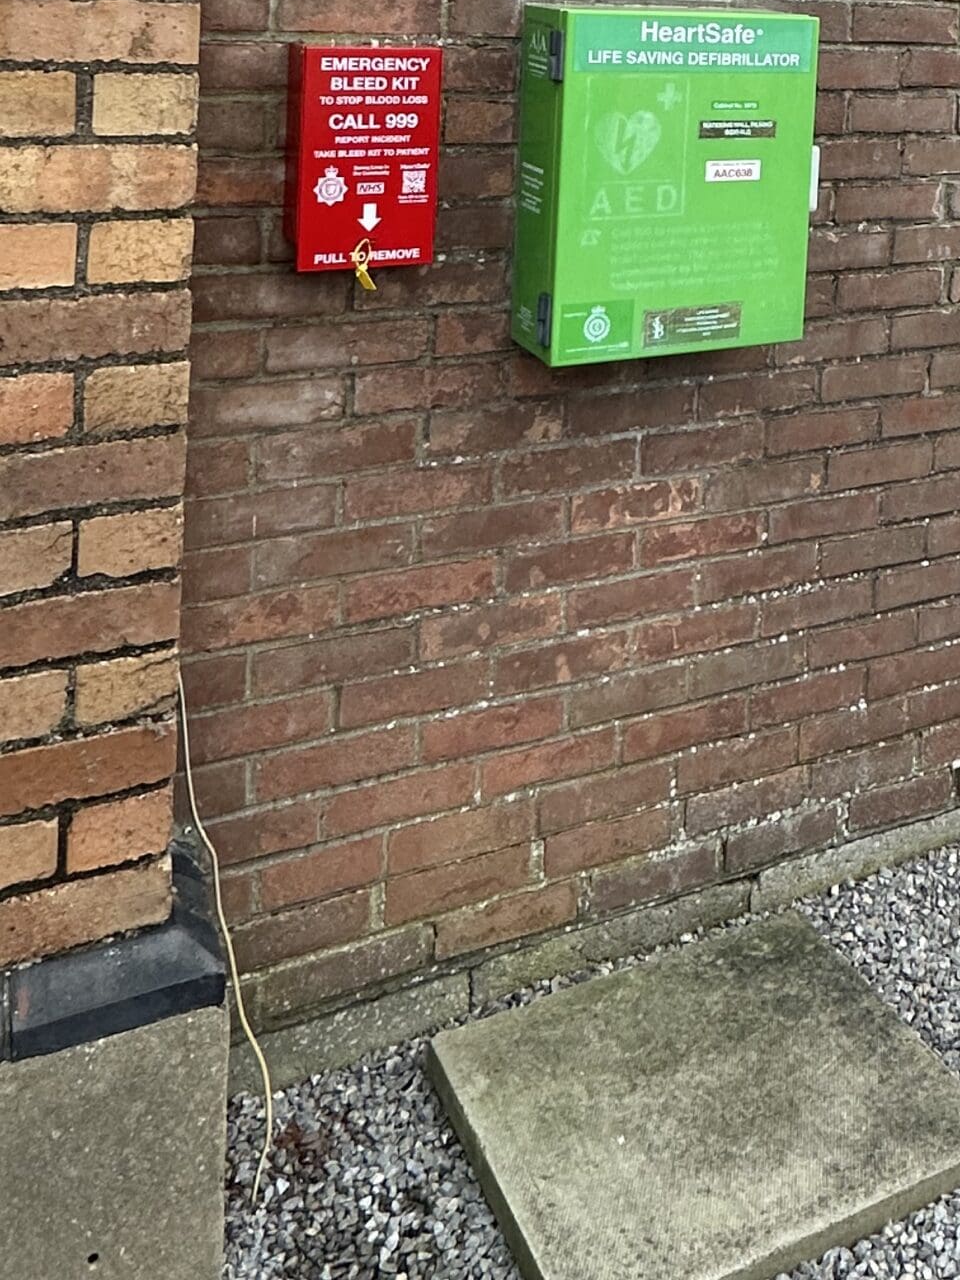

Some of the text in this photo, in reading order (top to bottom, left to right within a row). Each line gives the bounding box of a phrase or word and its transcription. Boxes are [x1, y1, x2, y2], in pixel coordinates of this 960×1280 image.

[321, 57, 430, 71] EMERGENCY
[588, 50, 800, 67] LIFE SAVING DEFIBRILLATOR
[330, 77, 420, 90] BLEED KIT
[319, 95, 428, 106] TO STOP BLOOD LOSS
[328, 113, 419, 130] CALL 999
[335, 135, 411, 144] REPORT INCIDENT
[383, 148, 395, 156] TO
[314, 248, 420, 264] PULL TO REMOVE
